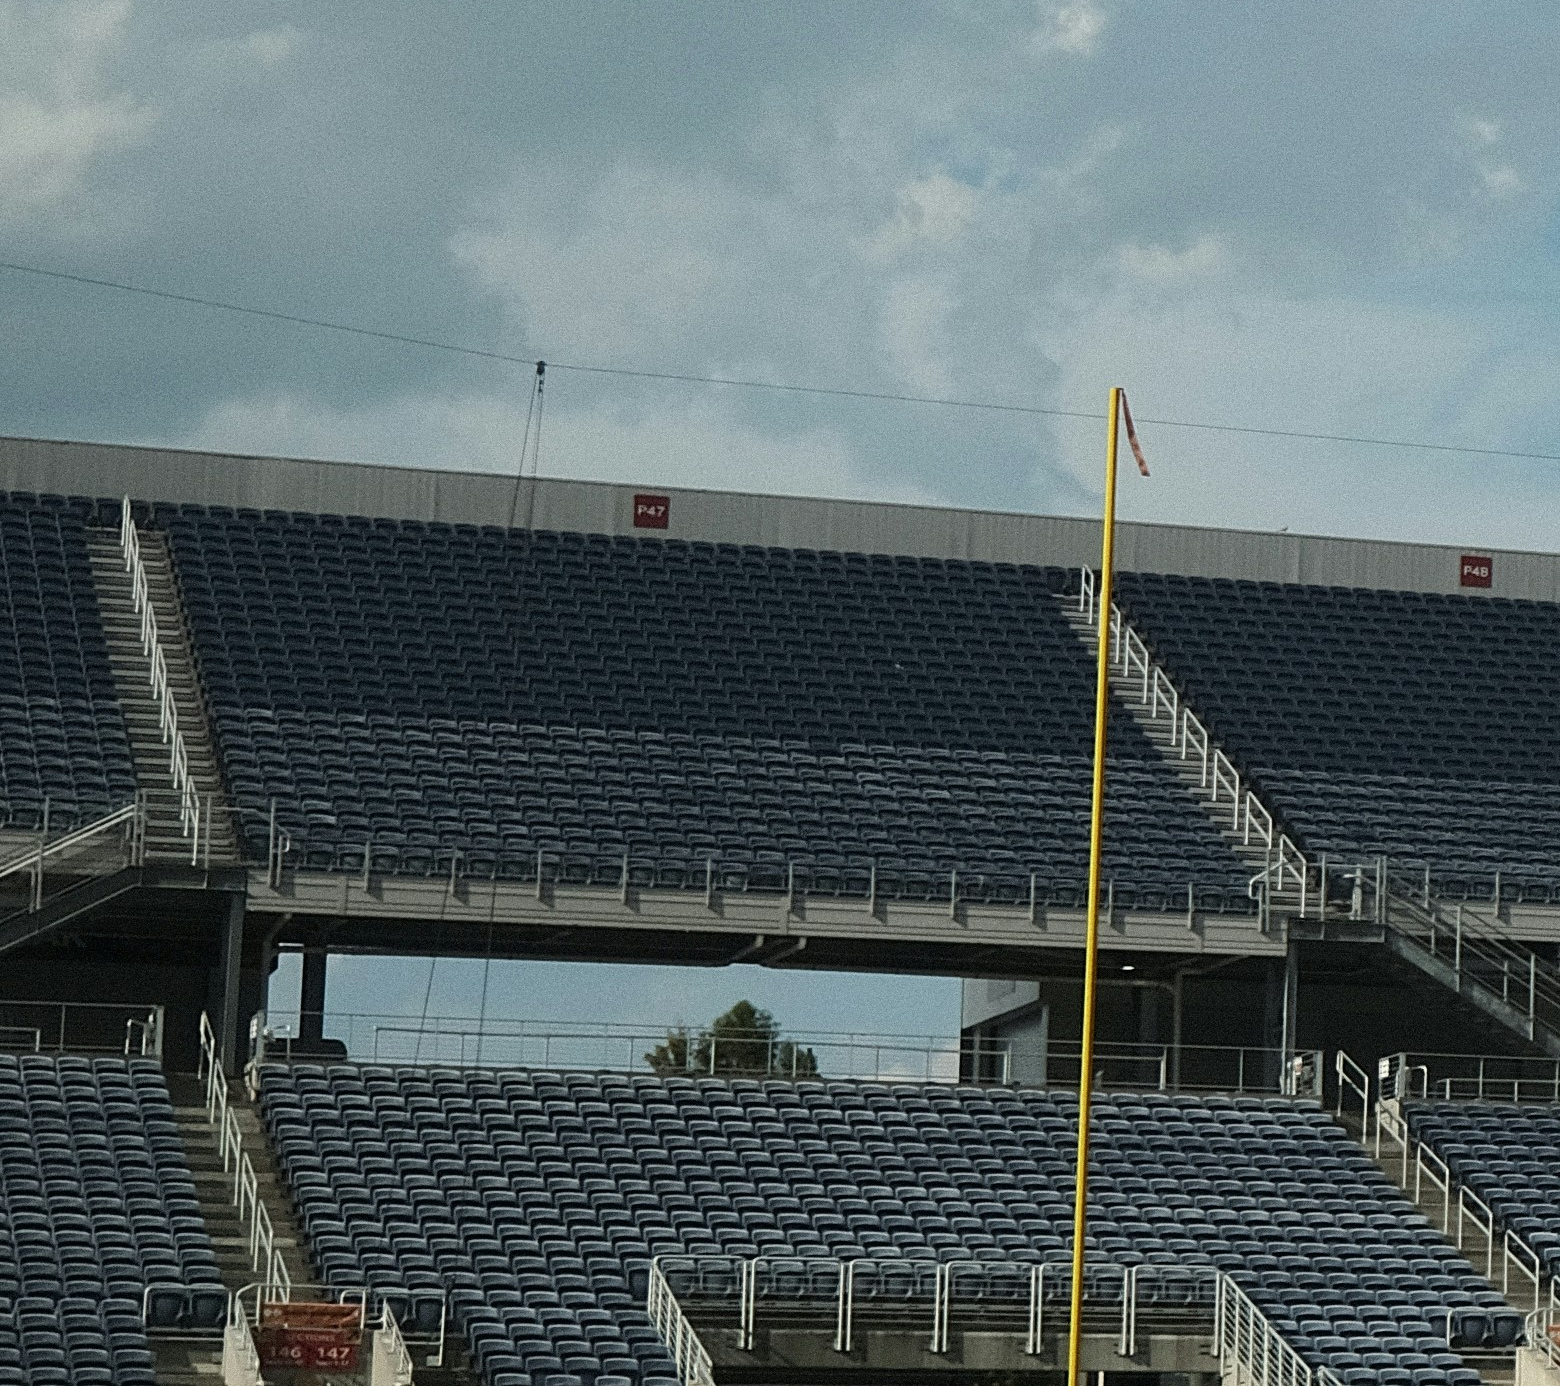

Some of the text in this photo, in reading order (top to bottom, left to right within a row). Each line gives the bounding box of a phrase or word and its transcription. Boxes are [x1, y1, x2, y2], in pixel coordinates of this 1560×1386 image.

[637, 504, 666, 518] P47
[1463, 564, 1489, 578] P48
[317, 1346, 351, 1359] 147
